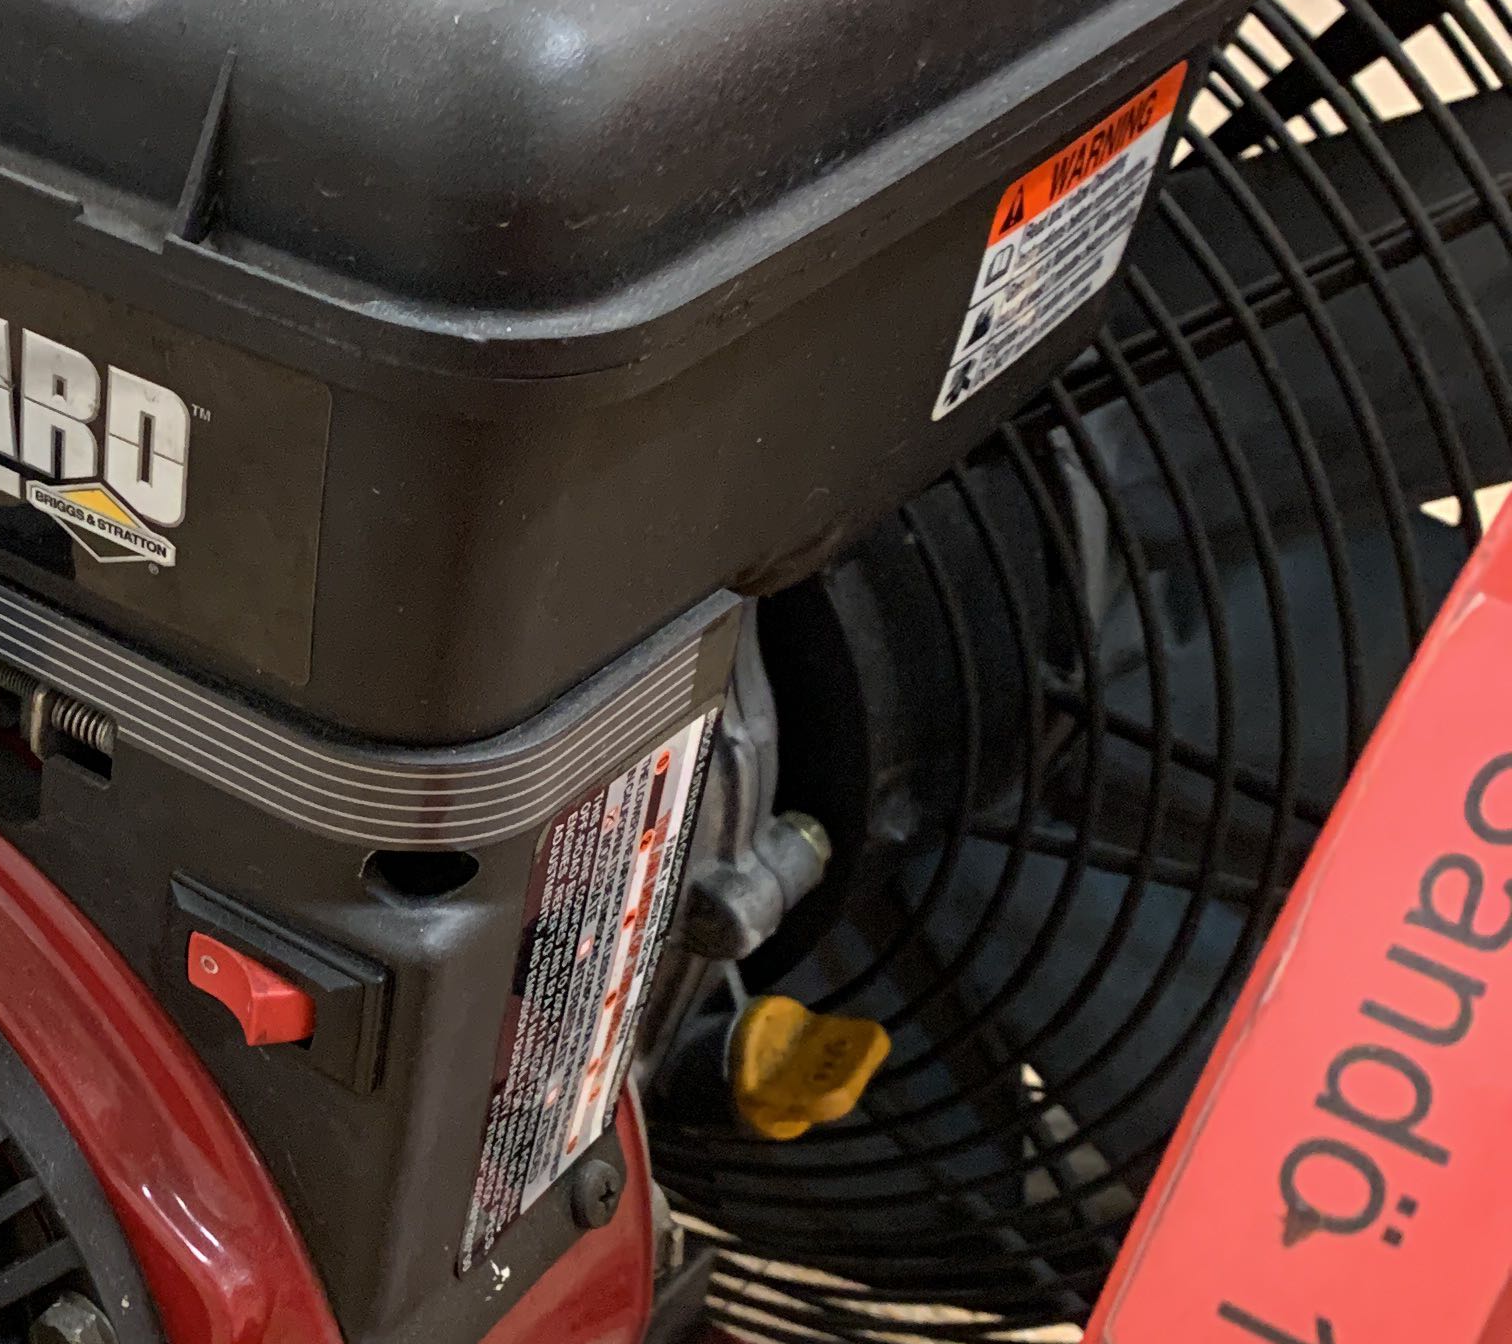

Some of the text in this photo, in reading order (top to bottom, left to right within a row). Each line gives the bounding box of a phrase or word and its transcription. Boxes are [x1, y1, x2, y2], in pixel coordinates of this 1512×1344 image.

[1048, 89, 1159, 203] WARNING
[35, 489, 167, 559] BRIGGS & STRATTON
[584, 826, 614, 927] MODERATE
